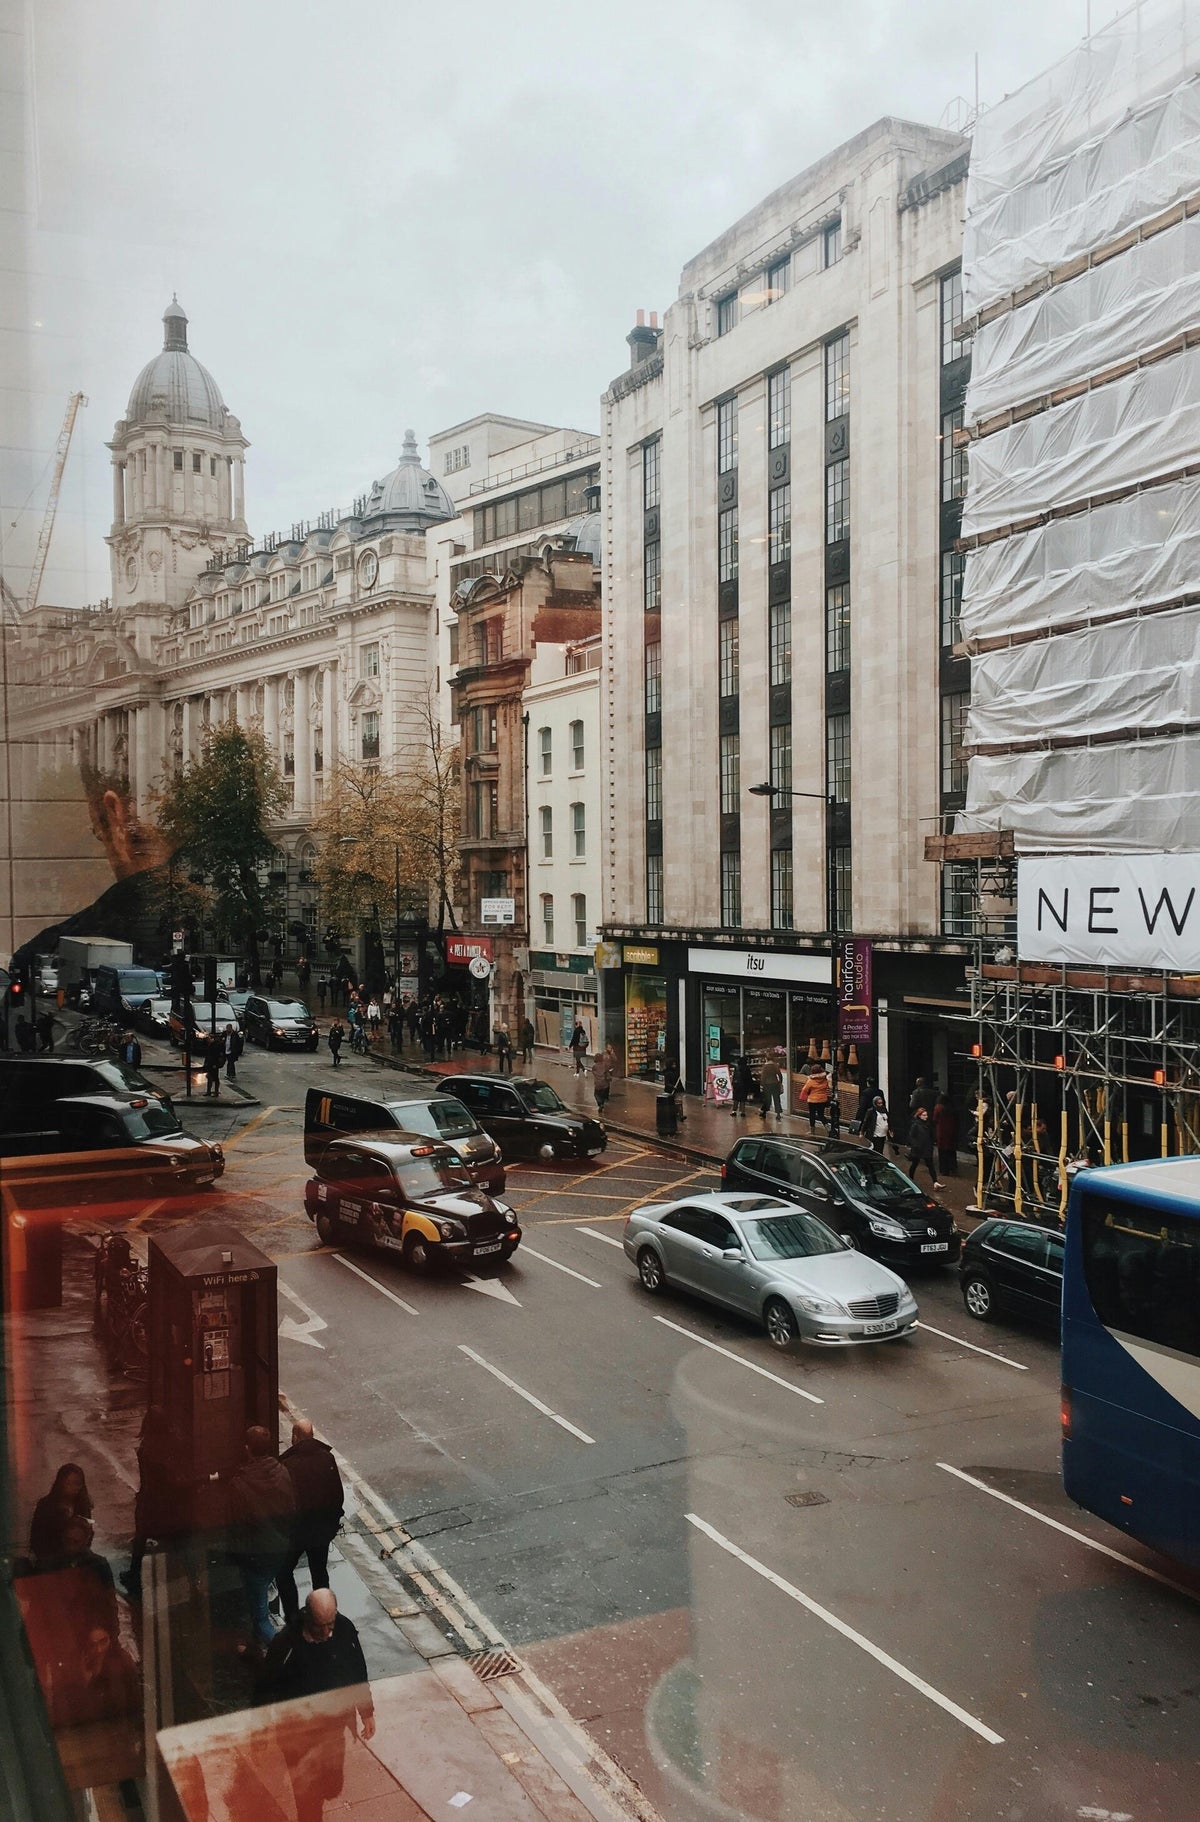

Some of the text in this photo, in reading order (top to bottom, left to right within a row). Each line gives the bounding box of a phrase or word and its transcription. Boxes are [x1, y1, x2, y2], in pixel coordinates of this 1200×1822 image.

[1037, 887, 1195, 936] NEW
[746, 954, 765, 971] itsu
[841, 942, 854, 1001] hairform
[854, 953, 864, 991] studio
[203, 1274, 248, 1286] WiFi here
